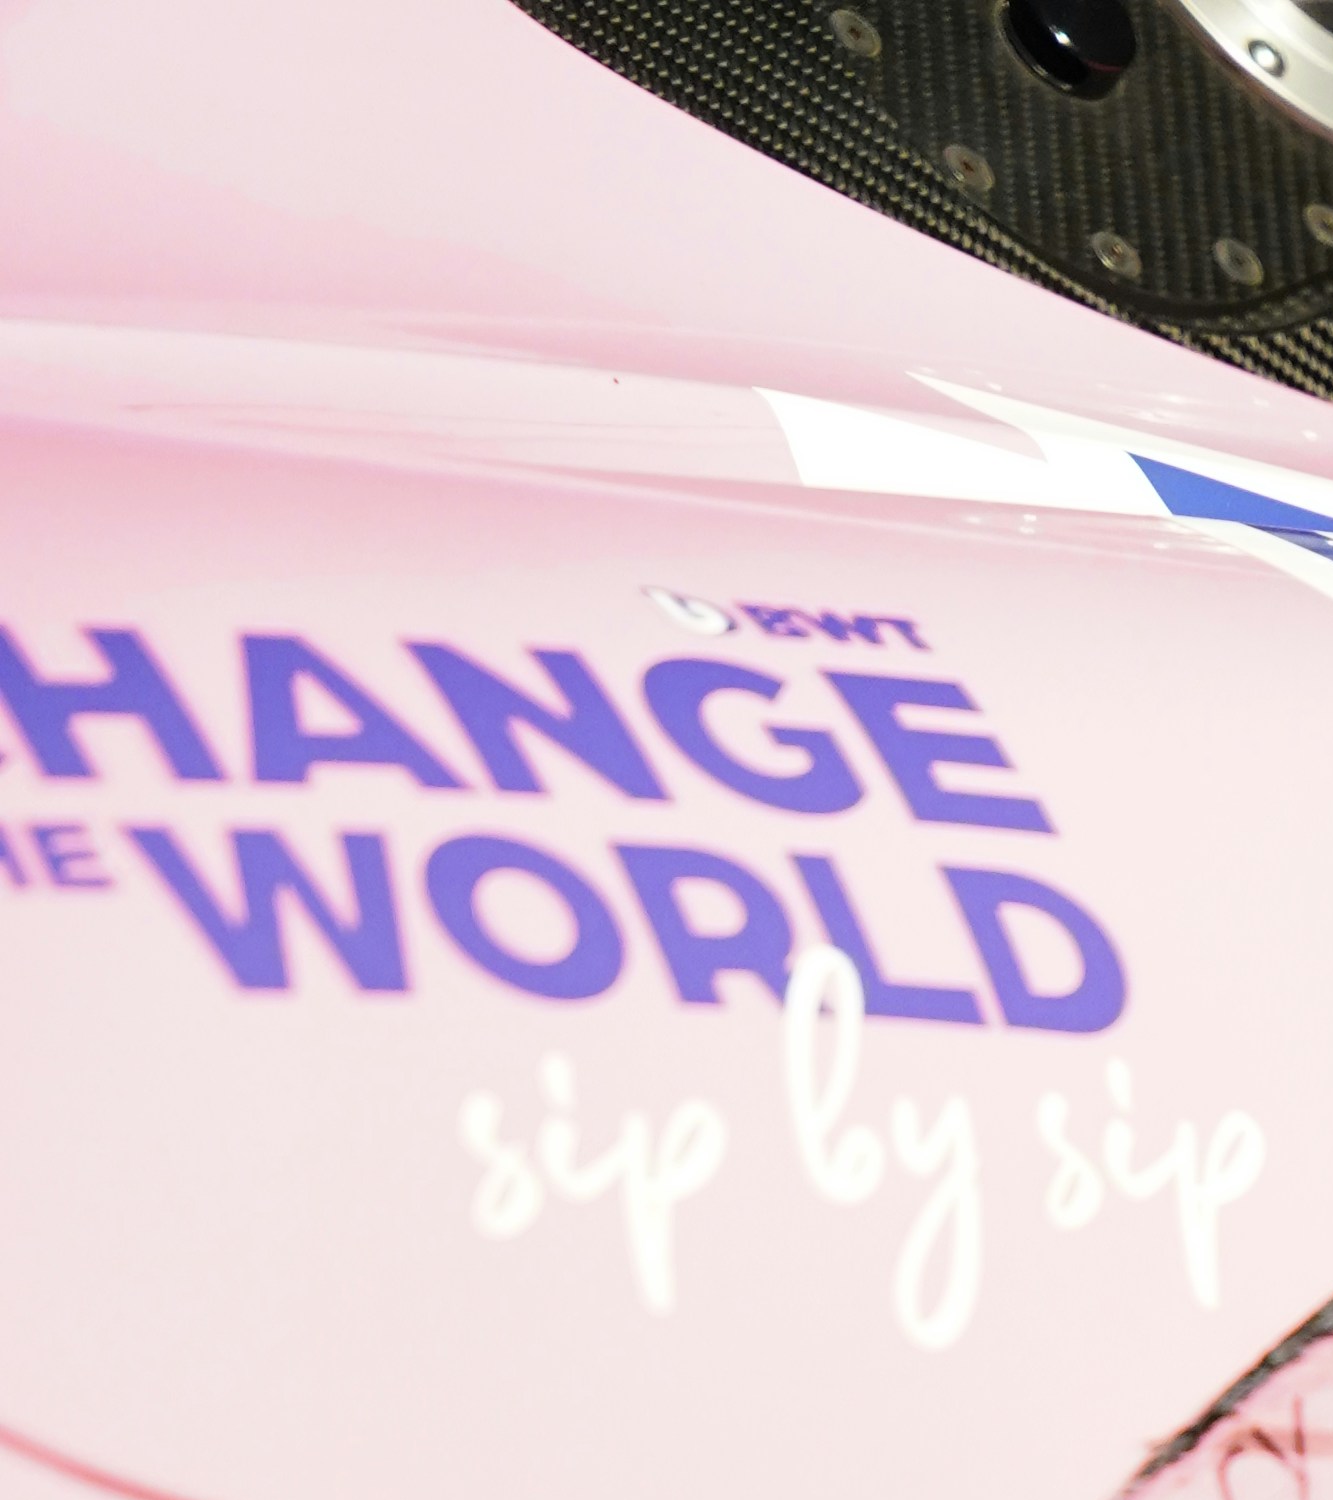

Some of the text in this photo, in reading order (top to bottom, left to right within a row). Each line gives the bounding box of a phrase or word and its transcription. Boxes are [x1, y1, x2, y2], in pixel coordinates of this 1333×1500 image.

[0, 623, 1060, 836] HANGE
[120, 825, 1132, 1036] WORLD
[458, 943, 1268, 1349] sip by sip
